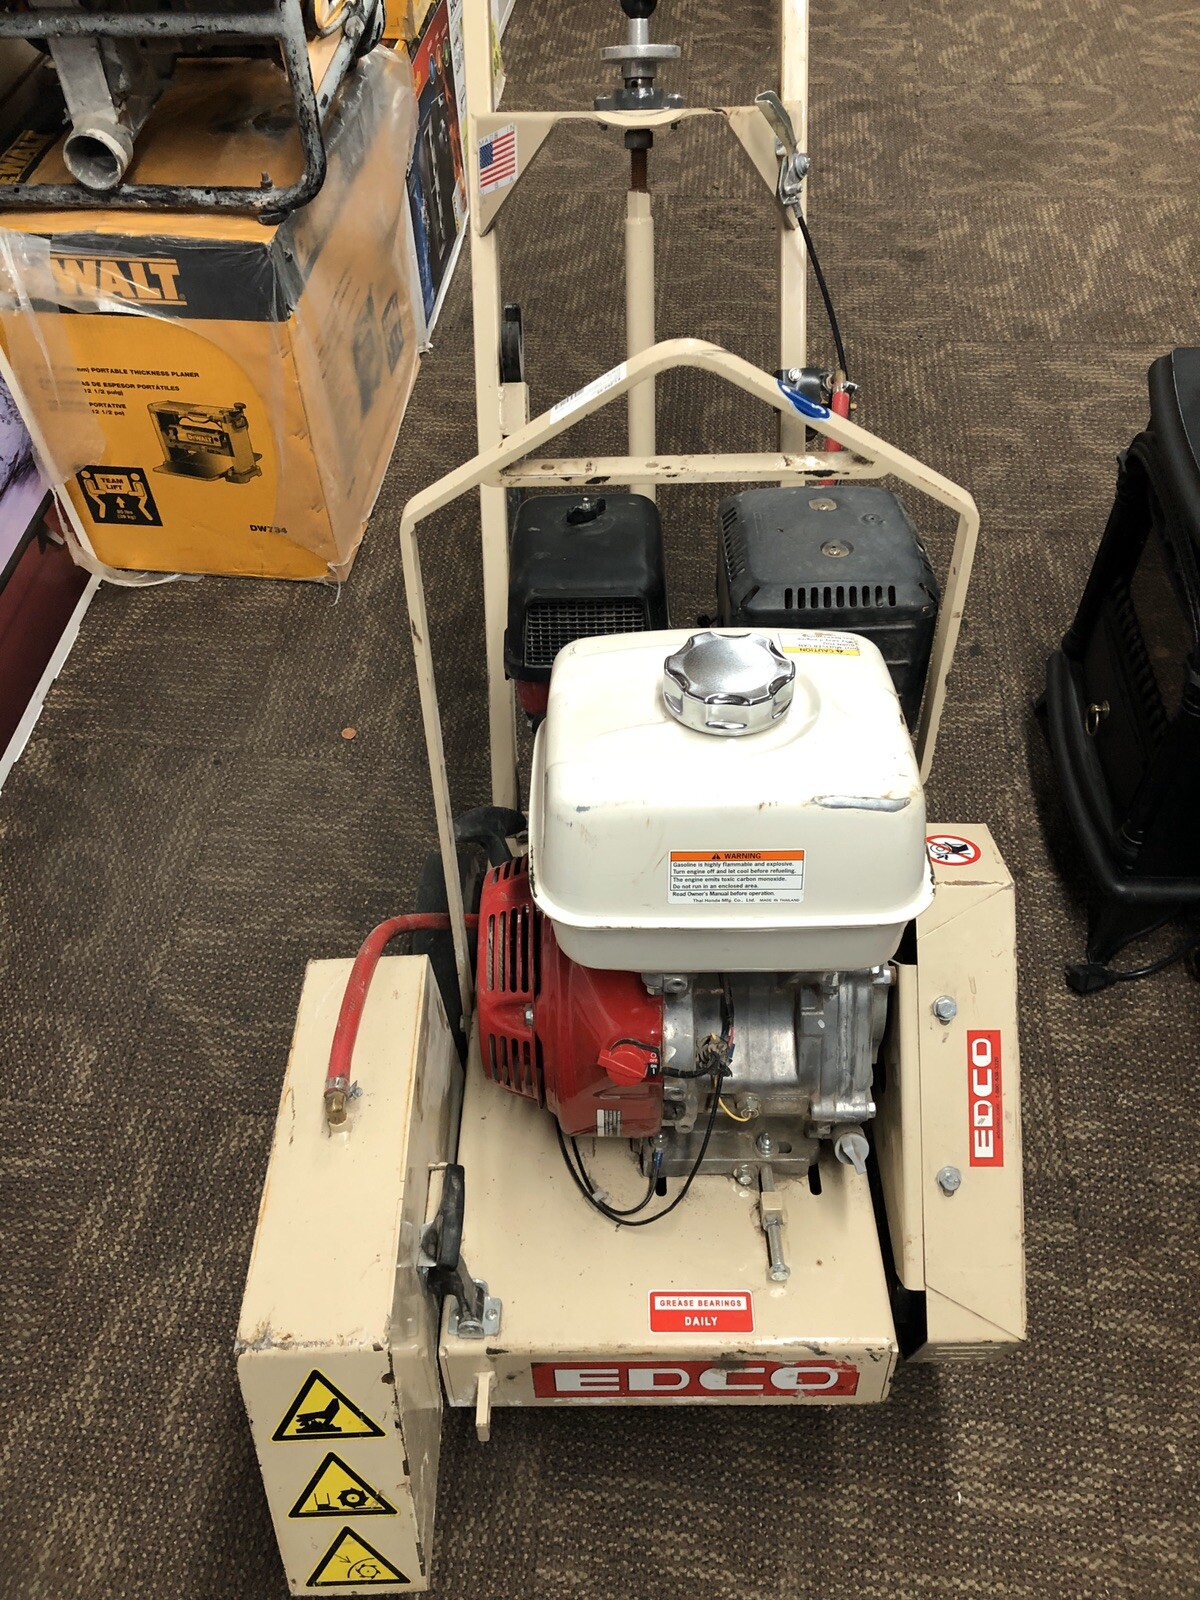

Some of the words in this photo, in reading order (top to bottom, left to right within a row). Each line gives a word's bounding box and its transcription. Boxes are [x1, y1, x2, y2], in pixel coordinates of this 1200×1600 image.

[48, 256, 181, 303] WALT
[91, 367, 128, 375] PORTABLE
[130, 369, 170, 377] THICKNESS
[100, 477, 124, 485] TEAM
[724, 852, 762, 860] WARNING
[971, 1037, 994, 1159] EDCO
[660, 1299, 694, 1307] GREASE
[697, 1299, 742, 1307] BEARINGS
[684, 1316, 718, 1326] DAILY
[553, 1366, 839, 1392] EDCO
